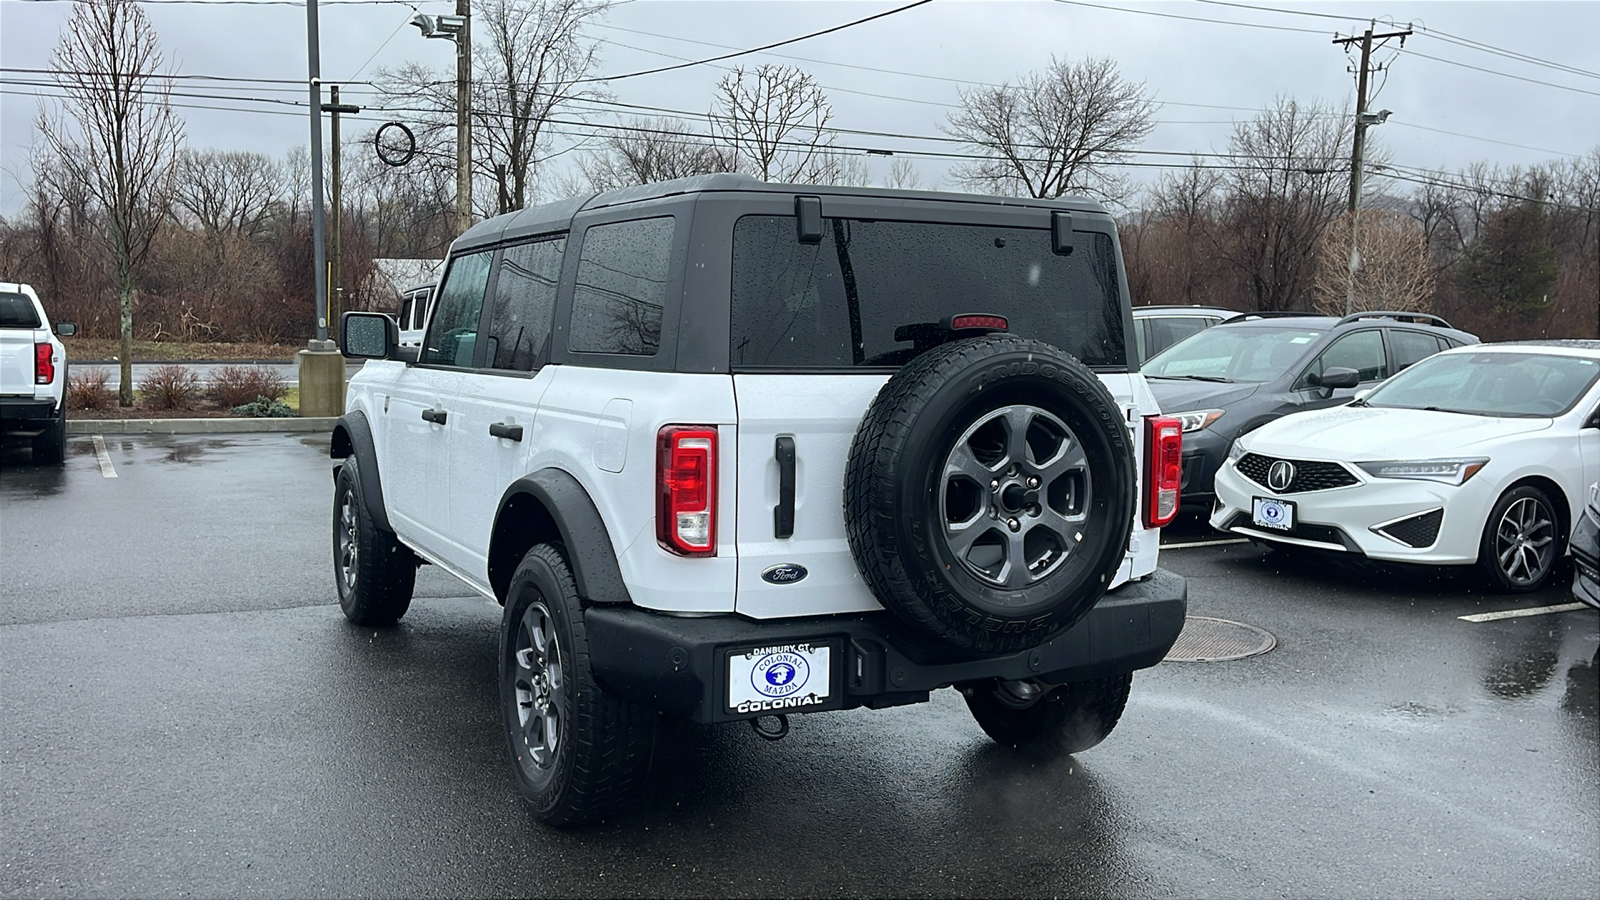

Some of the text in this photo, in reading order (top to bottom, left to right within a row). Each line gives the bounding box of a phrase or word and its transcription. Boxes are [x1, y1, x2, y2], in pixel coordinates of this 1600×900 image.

[969, 361, 1127, 458] BRIDGESTONE
[772, 568, 798, 580] Ford
[797, 643, 810, 652] CT
[758, 654, 803, 671] COLONIAL
[763, 682, 798, 694] MAZDA
[737, 695, 823, 713] COLONIAL
